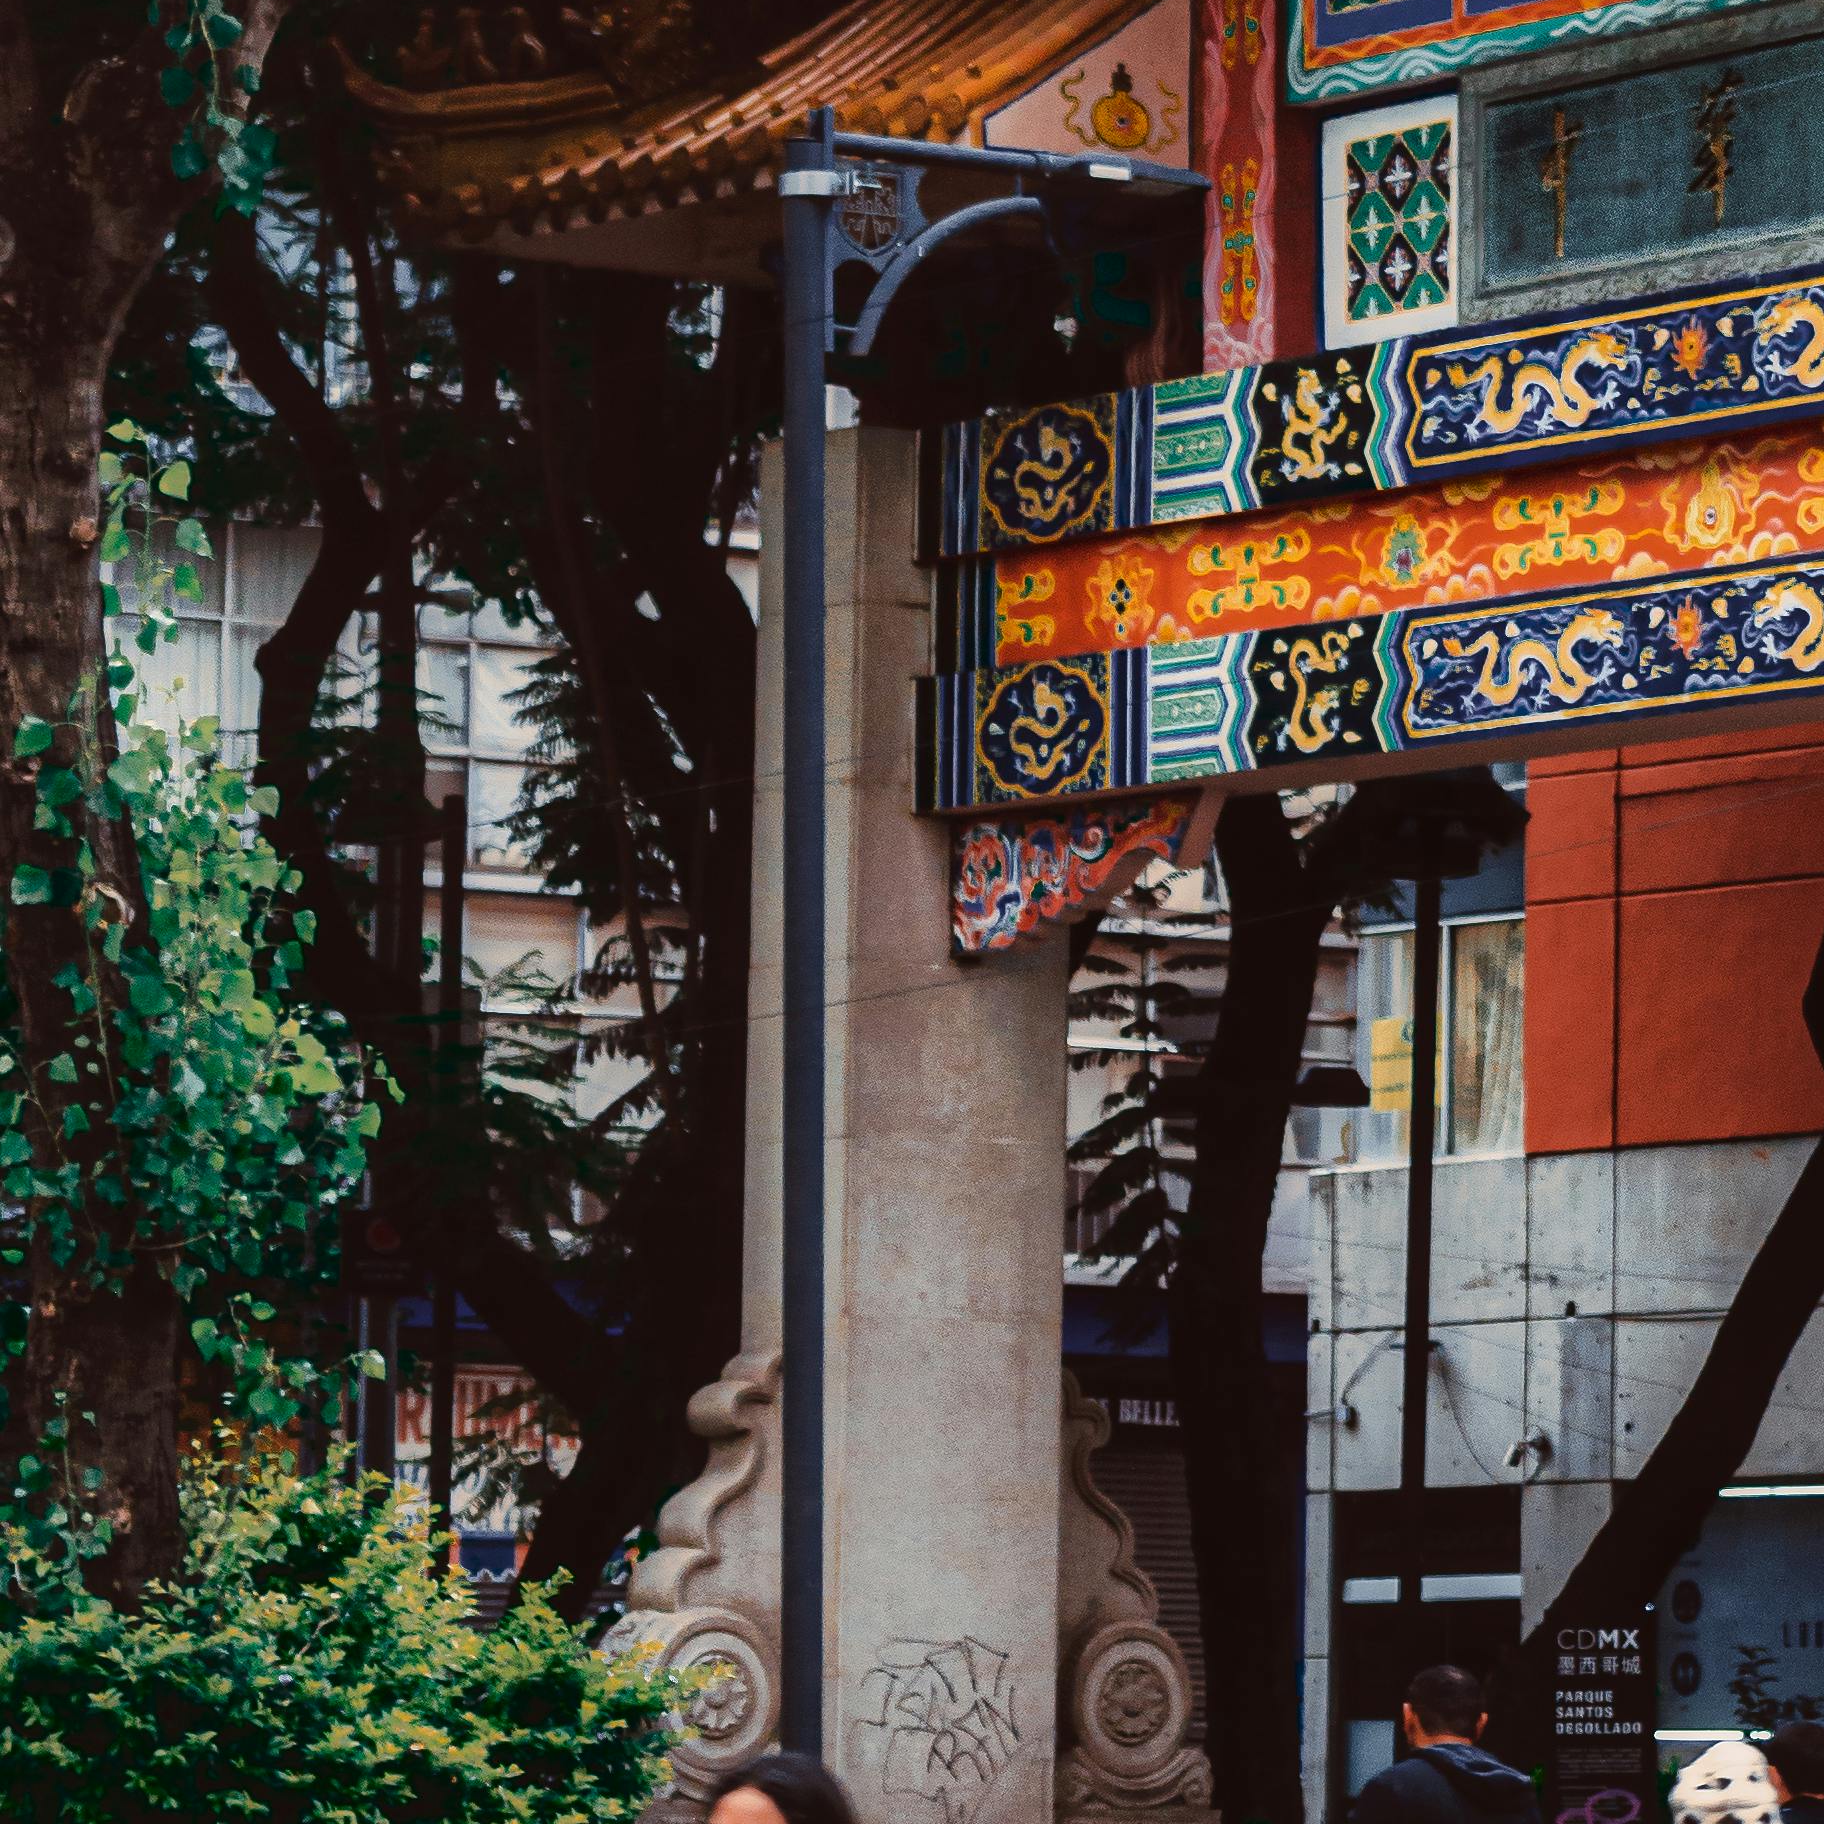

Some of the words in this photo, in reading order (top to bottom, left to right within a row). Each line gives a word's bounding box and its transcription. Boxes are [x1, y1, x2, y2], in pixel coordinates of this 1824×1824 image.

[1557, 1628, 1640, 1649] CDMX
[1558, 1655, 1642, 1675] 墨西哥城
[1555, 1690, 1614, 1703] PARQUE
[1555, 1706, 1614, 1718] SANTOS
[1555, 1722, 1642, 1734] DEGOLLADO
